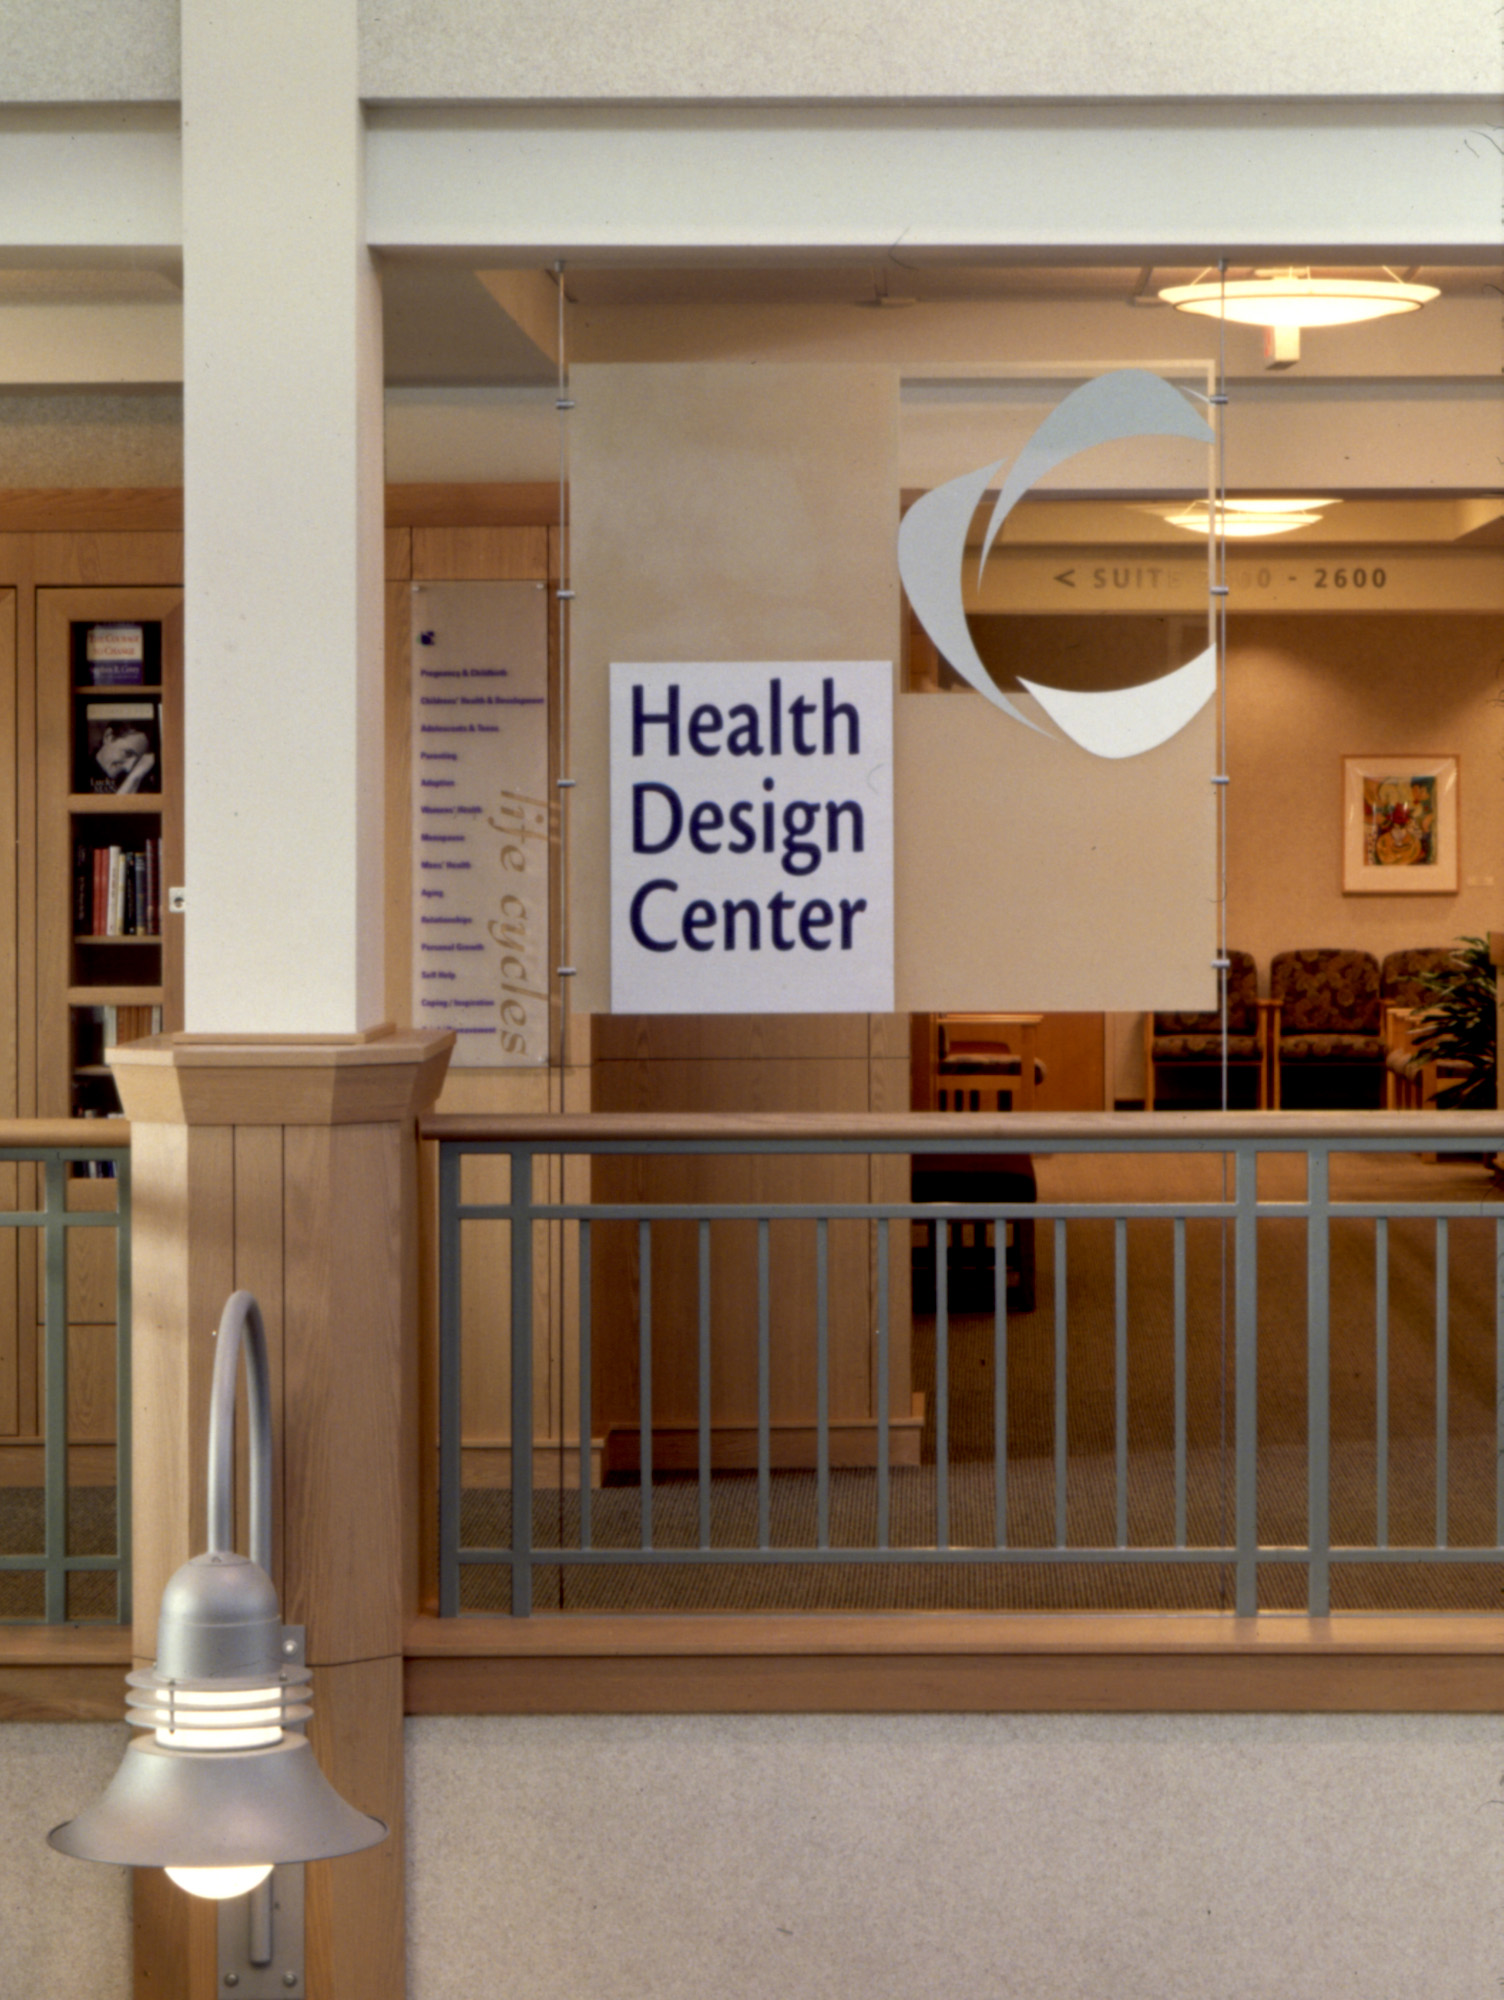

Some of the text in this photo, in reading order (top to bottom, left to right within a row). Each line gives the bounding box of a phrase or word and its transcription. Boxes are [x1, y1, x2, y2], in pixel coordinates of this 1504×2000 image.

[1313, 568, 1387, 589] 2600
[420, 668, 461, 679] Pregnancy
[460, 696, 486, 706] Health
[495, 696, 545, 707] Development
[631, 677, 861, 758] Health
[420, 723, 468, 734] Adolescents
[478, 723, 500, 733] Teens
[420, 751, 458, 762] Parenting
[420, 778, 456, 789] Adoption
[457, 805, 483, 815] Health
[631, 775, 865, 877] Design
[420, 833, 466, 844] Menopause
[446, 860, 473, 870] Health
[420, 888, 445, 899] Aging
[420, 915, 474, 926] Relationships
[629, 877, 868, 954] Center
[487, 789, 561, 1057] life cycles
[420, 942, 486, 951] Personal Growth
[421, 970, 457, 981] Self Help
[421, 998, 448, 1009] Coping
[453, 998, 496, 1009] Inspiration
